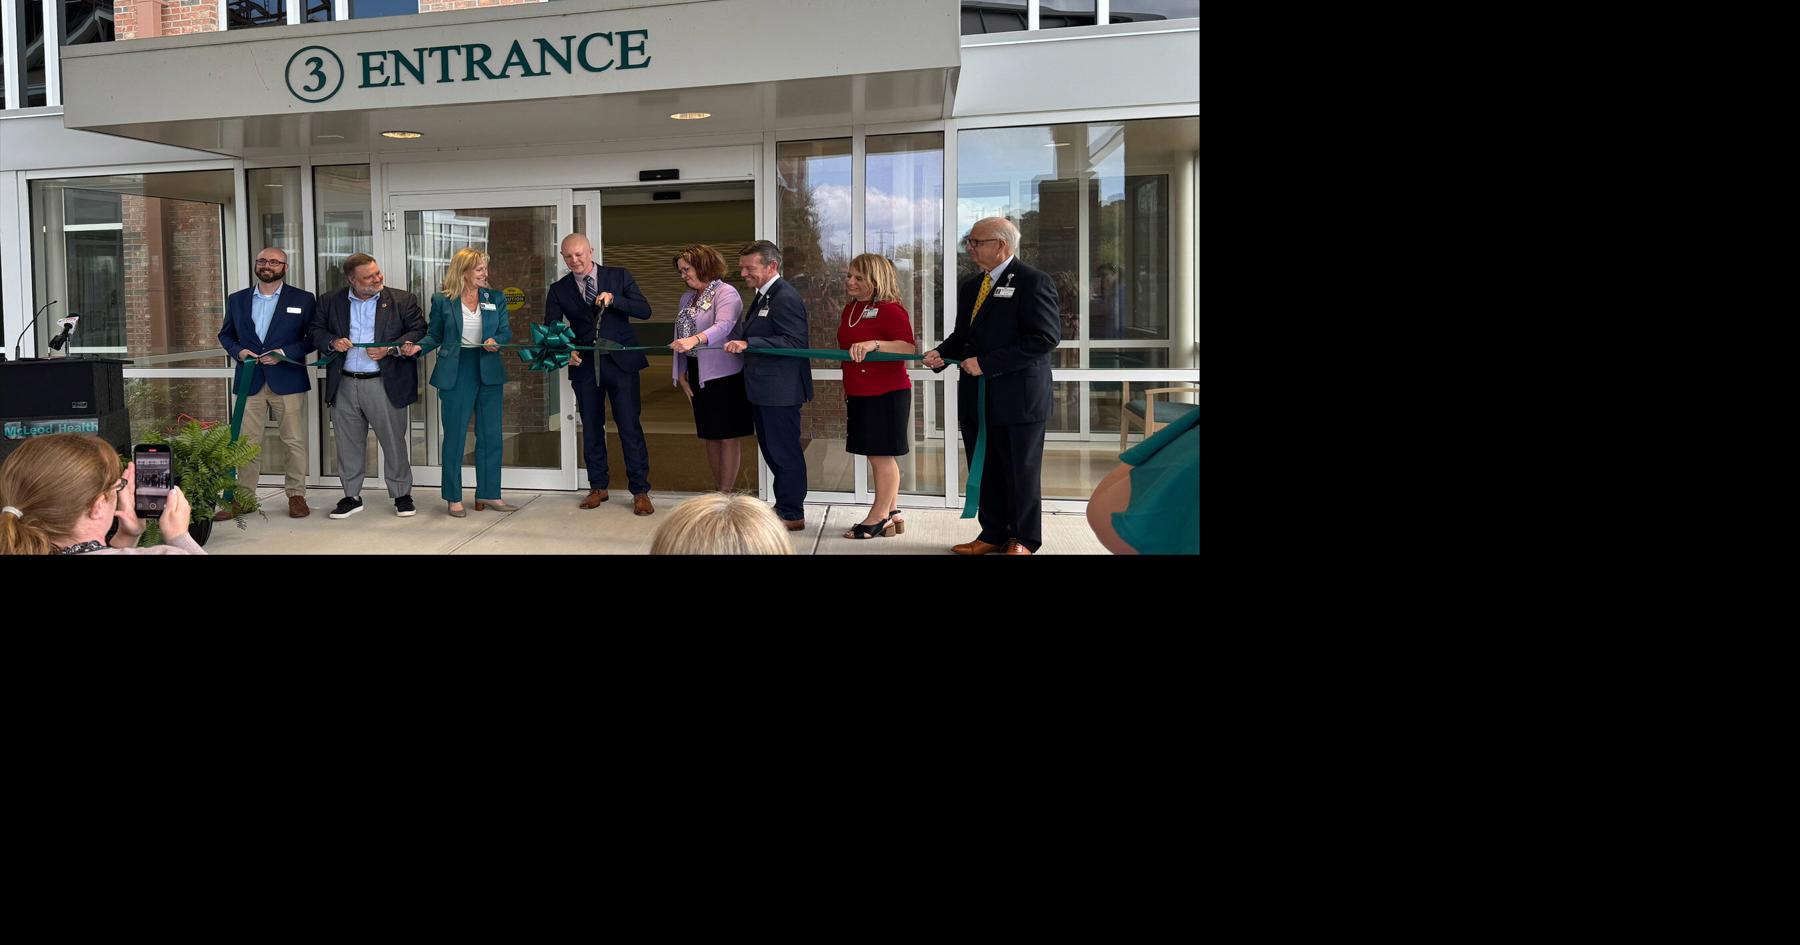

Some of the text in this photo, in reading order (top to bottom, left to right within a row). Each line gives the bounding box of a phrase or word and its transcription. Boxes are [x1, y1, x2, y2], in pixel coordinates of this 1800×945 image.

[303, 29, 651, 92] 3 ENTRANCE
[5, 421, 98, 436] McLeod Health
